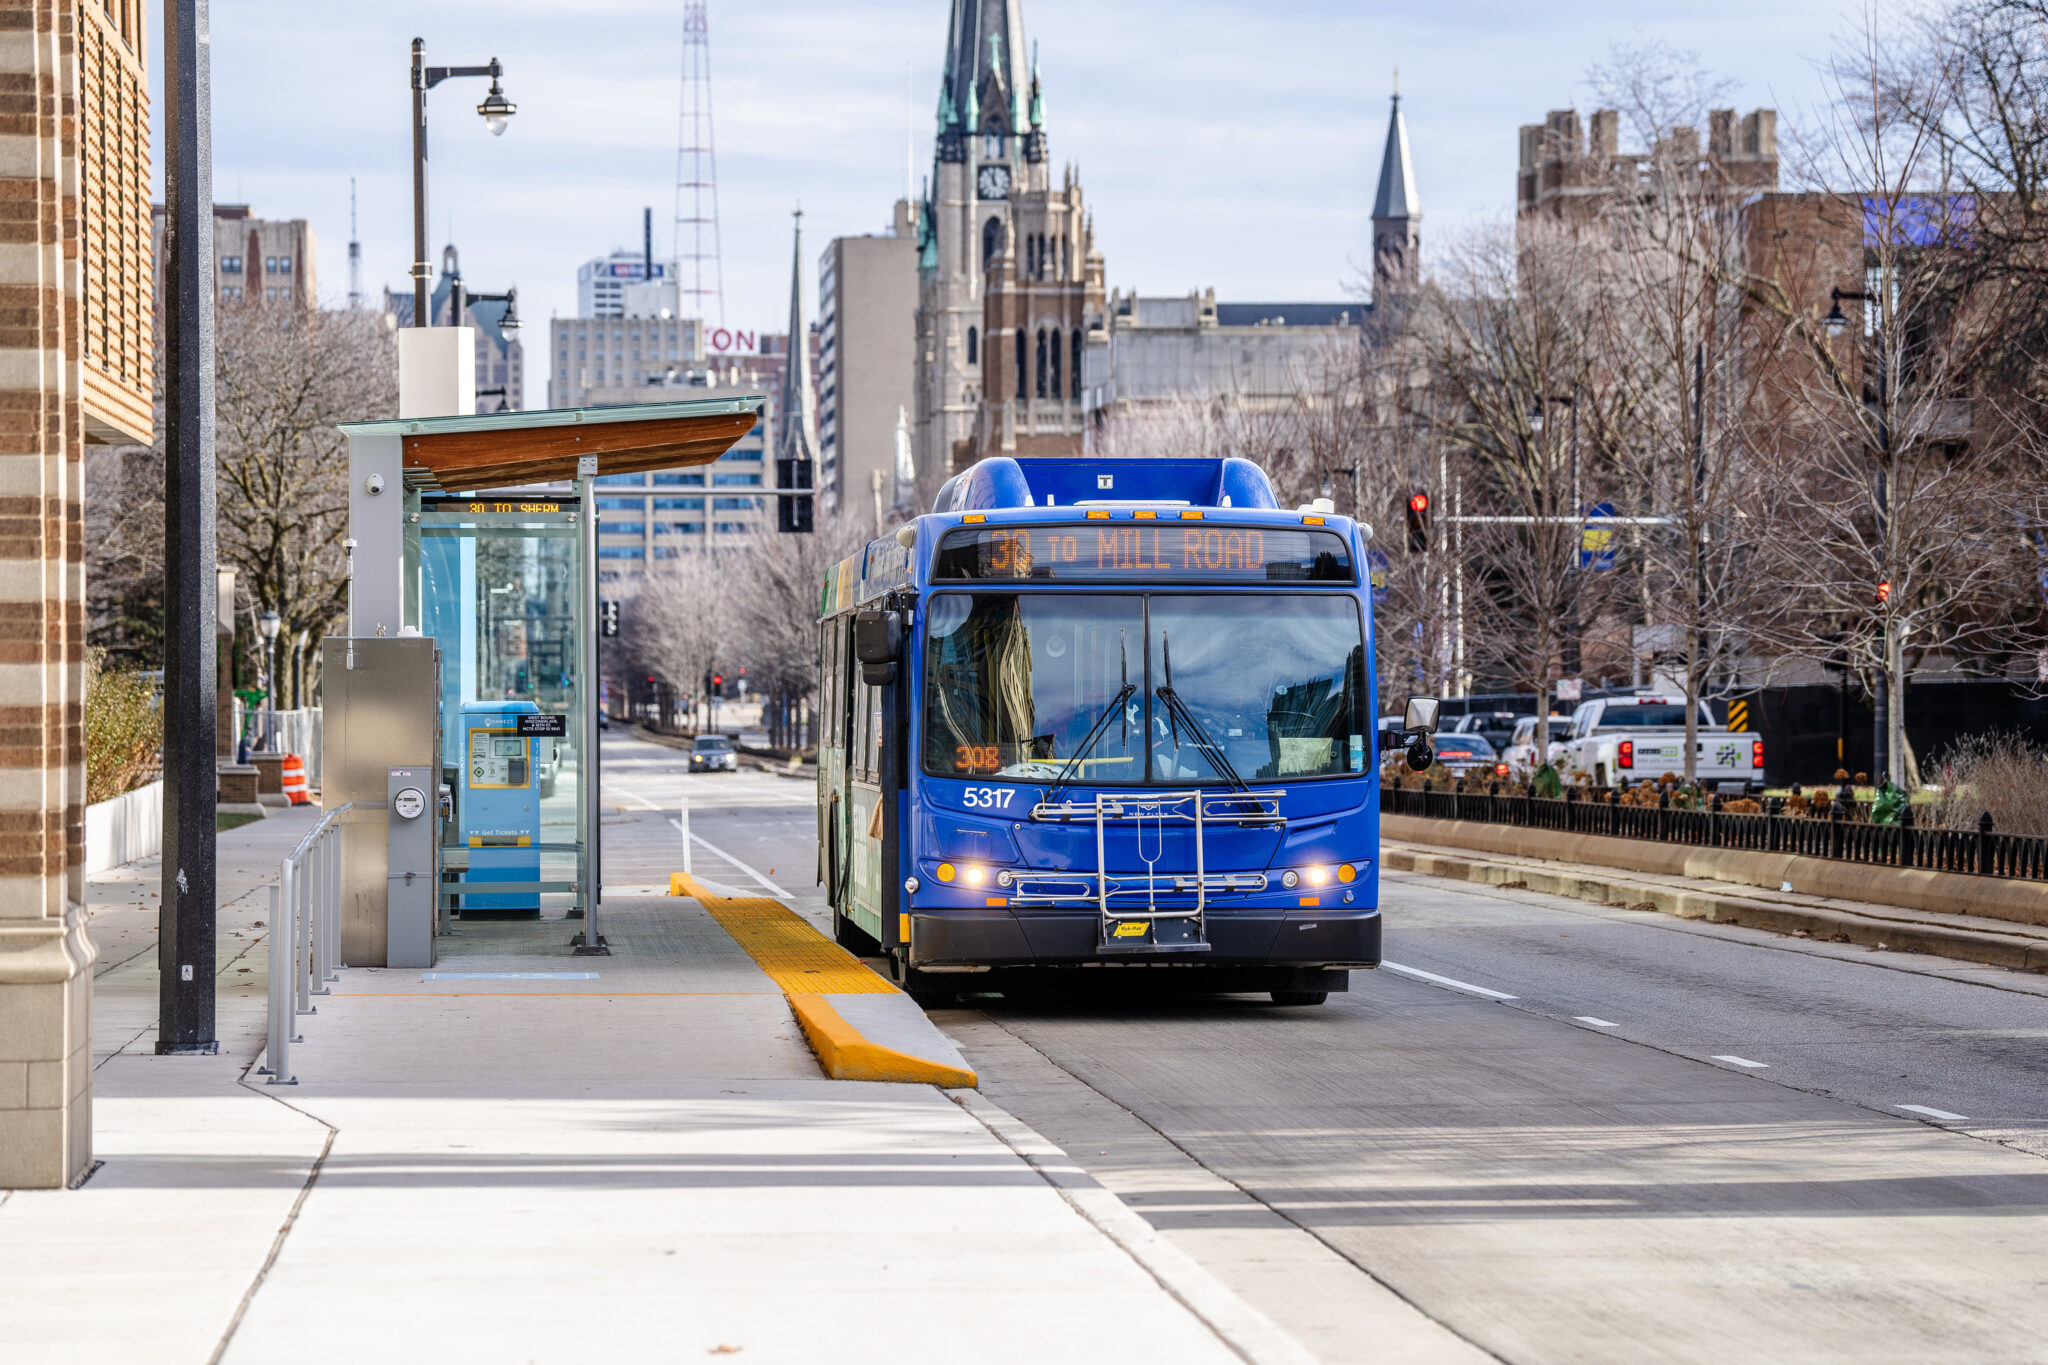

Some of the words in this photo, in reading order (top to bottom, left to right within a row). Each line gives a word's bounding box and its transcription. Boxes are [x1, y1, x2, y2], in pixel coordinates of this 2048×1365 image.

[705, 328, 754, 351] ON
[469, 503, 485, 513] 30
[493, 503, 512, 513] TO
[520, 503, 560, 513] SHERM
[990, 528, 1031, 570] 30
[1047, 535, 1077, 562] TO
[1097, 528, 1171, 570] MILL
[1184, 529, 1264, 569] ROAD
[955, 746, 999, 768] 308
[963, 787, 1016, 808] 5317
